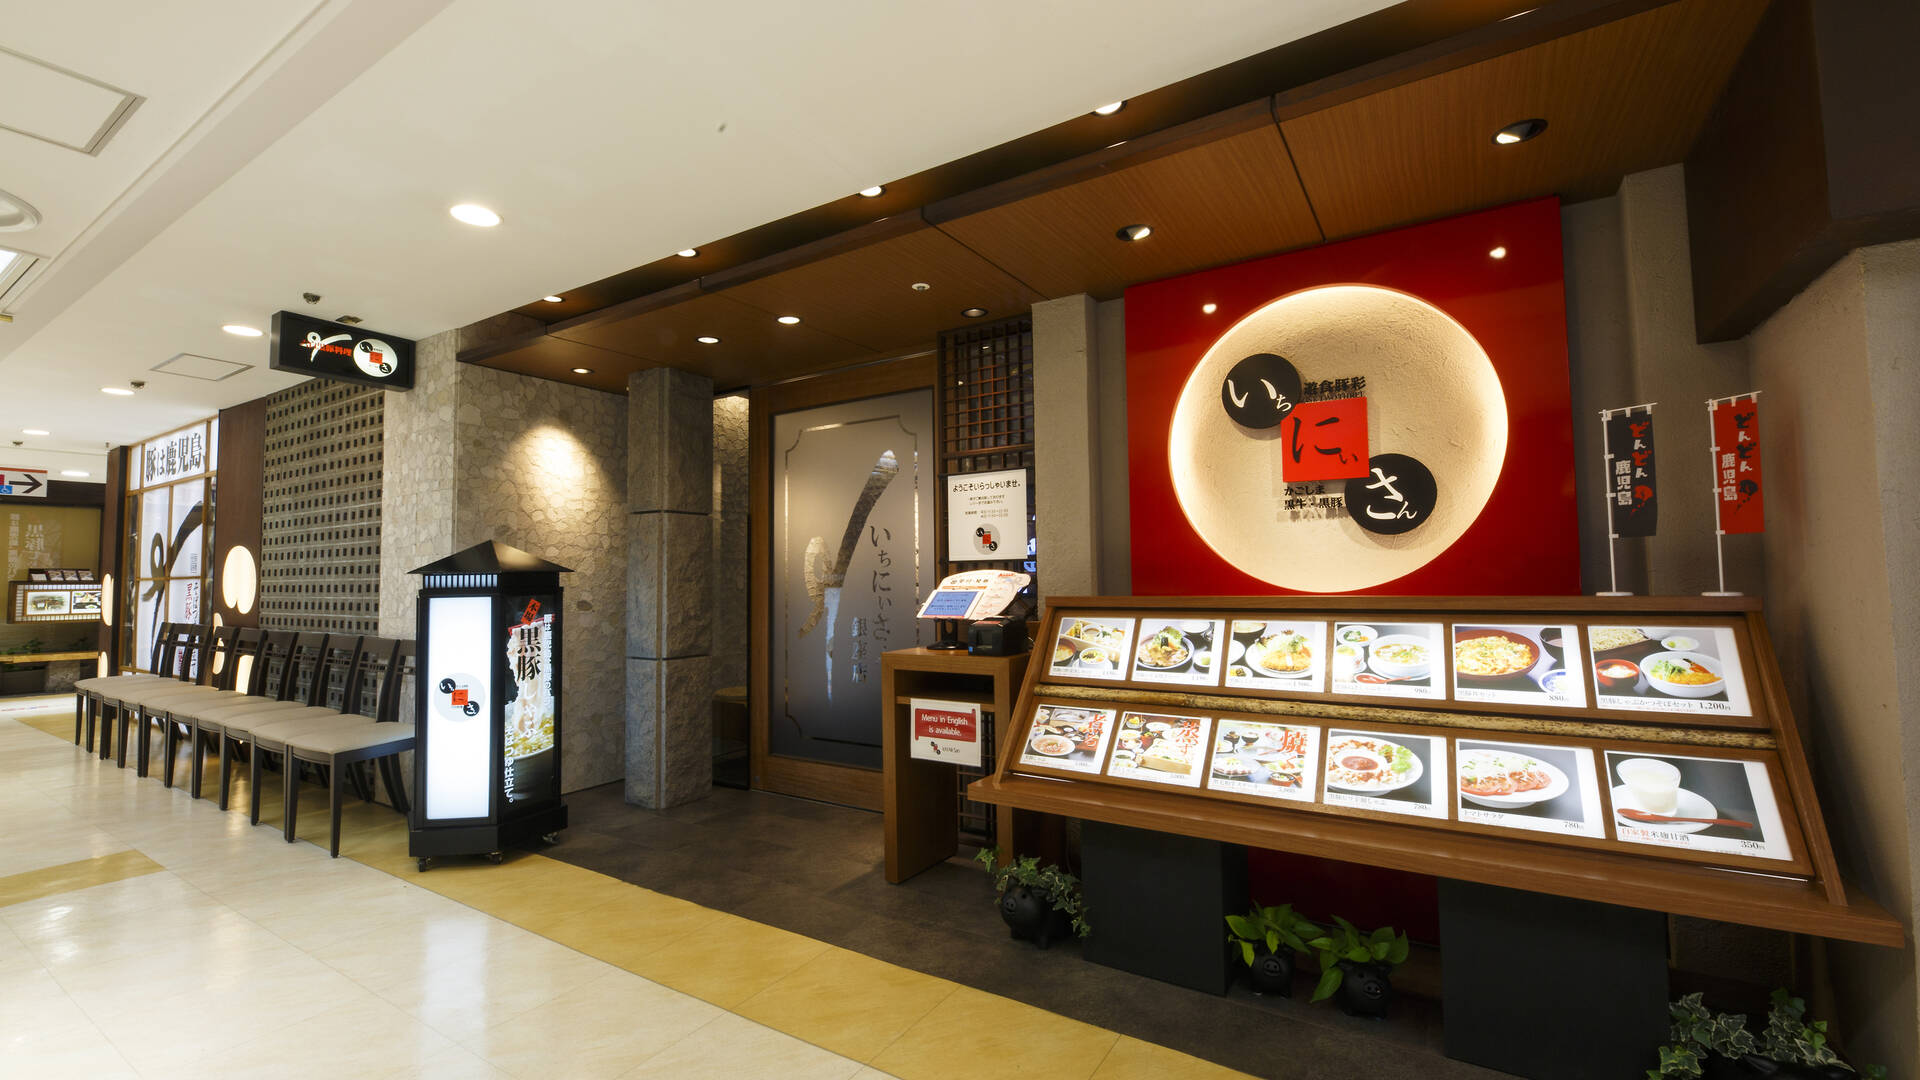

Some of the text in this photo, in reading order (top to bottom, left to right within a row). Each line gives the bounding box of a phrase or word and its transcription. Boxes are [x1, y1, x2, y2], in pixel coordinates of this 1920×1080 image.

[1228, 379, 1292, 411] いち
[1615, 460, 1632, 506] 鹿児島
[1722, 453, 1738, 501] 鹿児島
[953, 480, 1020, 492] ようこそいらっしゃいませ。
[1284, 485, 1325, 496] かごしま
[1366, 467, 1417, 520] さん
[517, 627, 541, 682] 黒豚
[1698, 702, 1731, 711] 1,200円
[921, 714, 968, 726] Menu in English
[935, 727, 962, 736] available.
[1740, 840, 1766, 851] 350円
